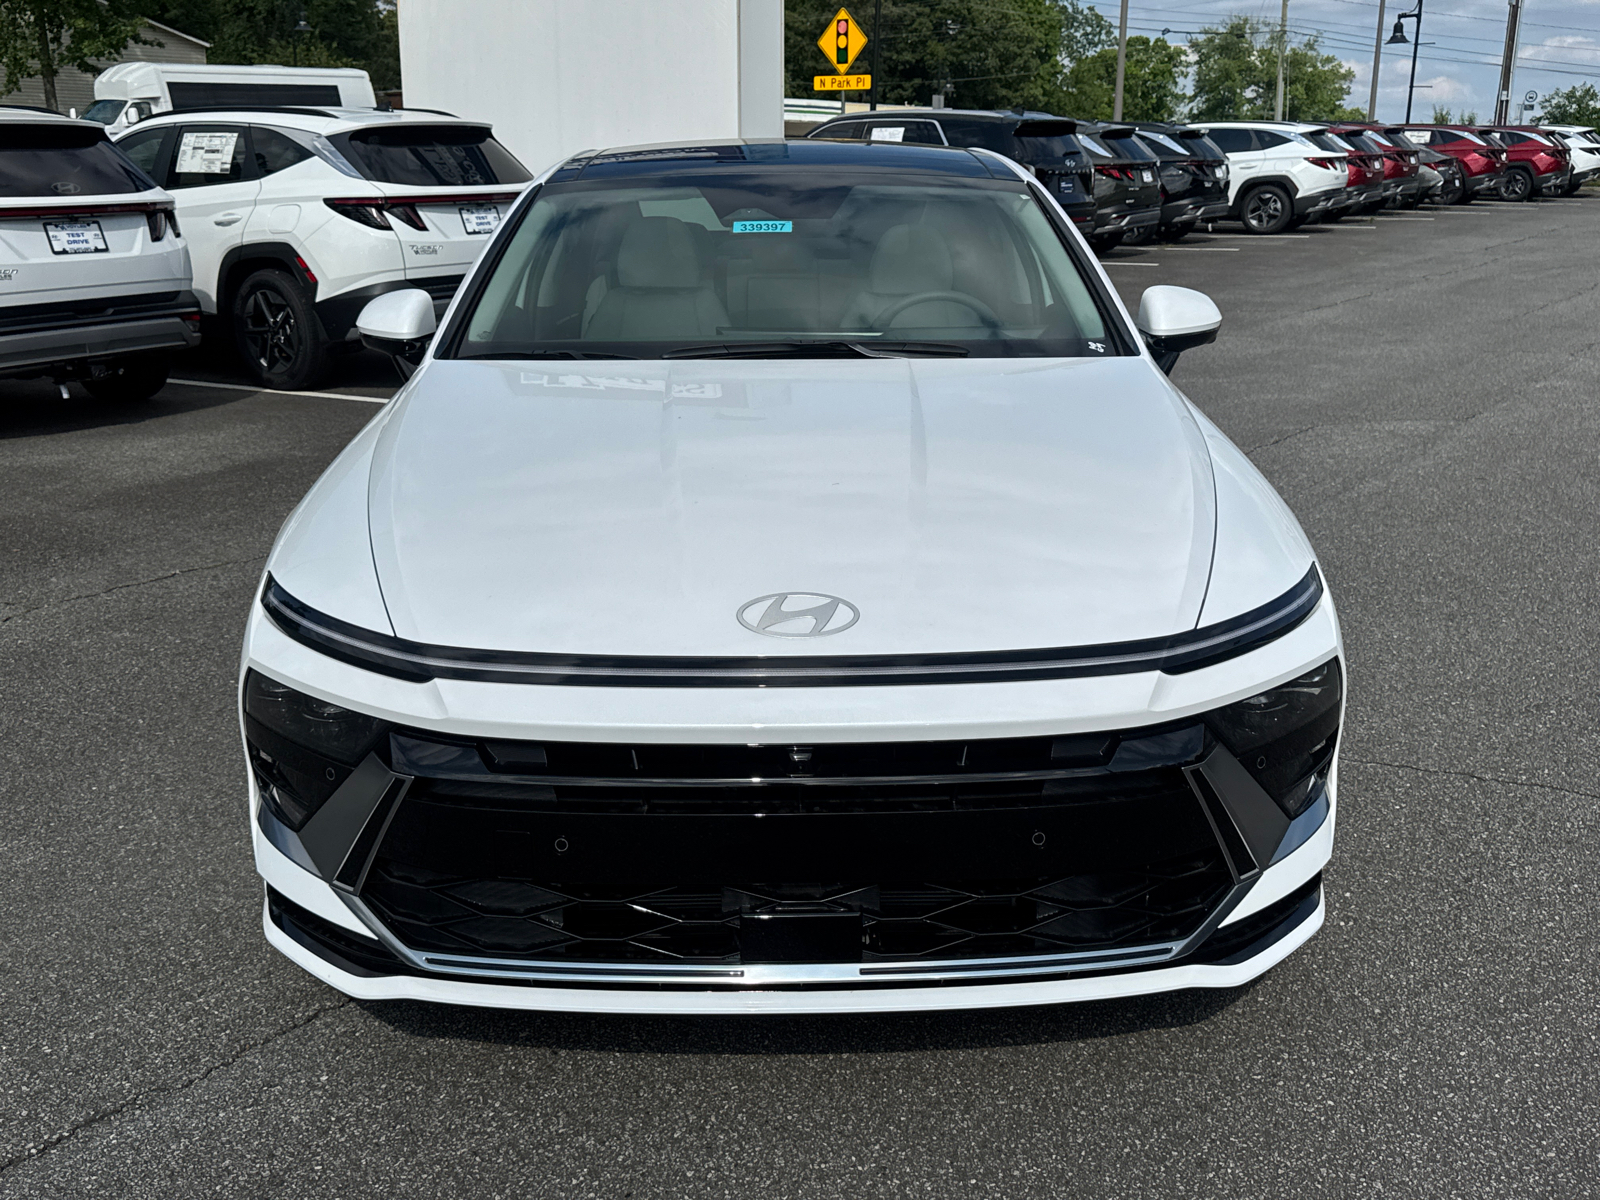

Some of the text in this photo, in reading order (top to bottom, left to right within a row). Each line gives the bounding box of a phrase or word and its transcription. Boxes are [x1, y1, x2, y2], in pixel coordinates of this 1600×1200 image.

[819, 76, 866, 89] N Park Pl
[740, 222, 786, 232] 339397
[66, 238, 90, 246] DRIVE
